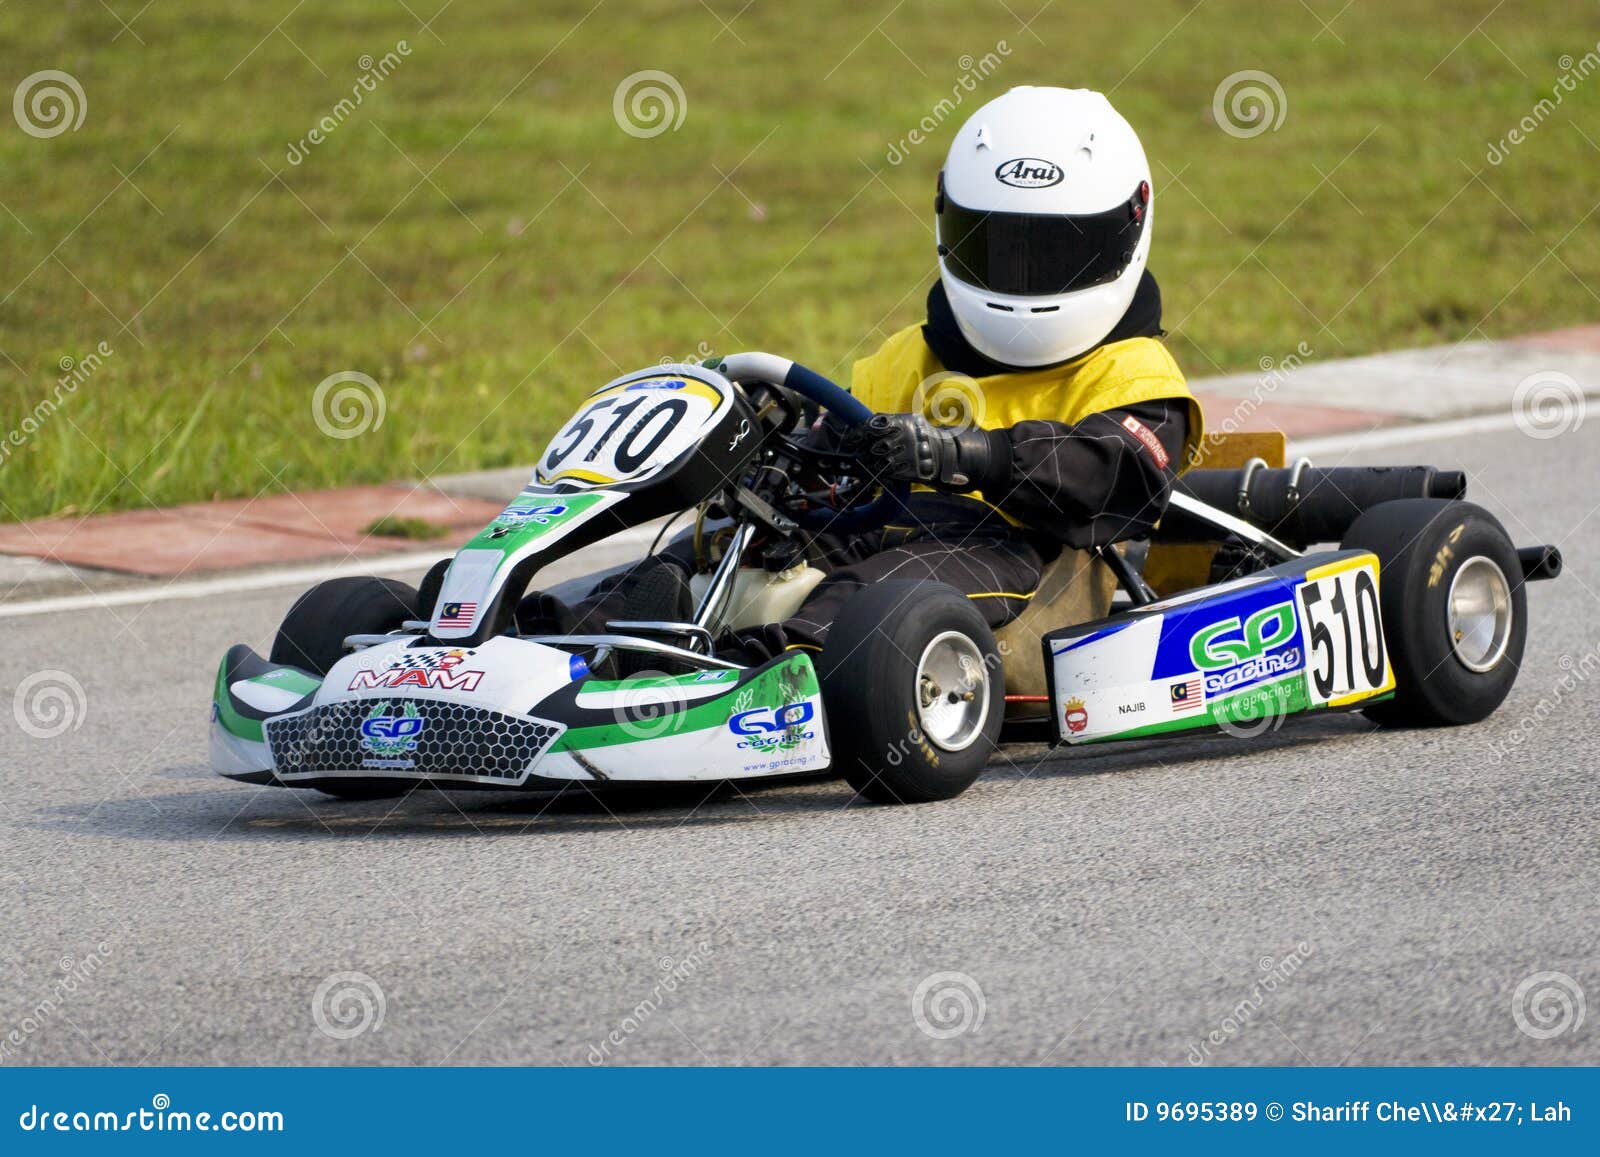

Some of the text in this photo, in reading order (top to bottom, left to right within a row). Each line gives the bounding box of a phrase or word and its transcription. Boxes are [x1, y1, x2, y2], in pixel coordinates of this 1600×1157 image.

[1000, 160, 1055, 180] Arai
[547, 395, 688, 473] 510
[1190, 600, 1298, 672] GP
[1301, 570, 1385, 699] 510
[347, 668, 486, 692] MAM
[728, 701, 814, 736] GP
[1119, 702, 1146, 715] NAJIB
